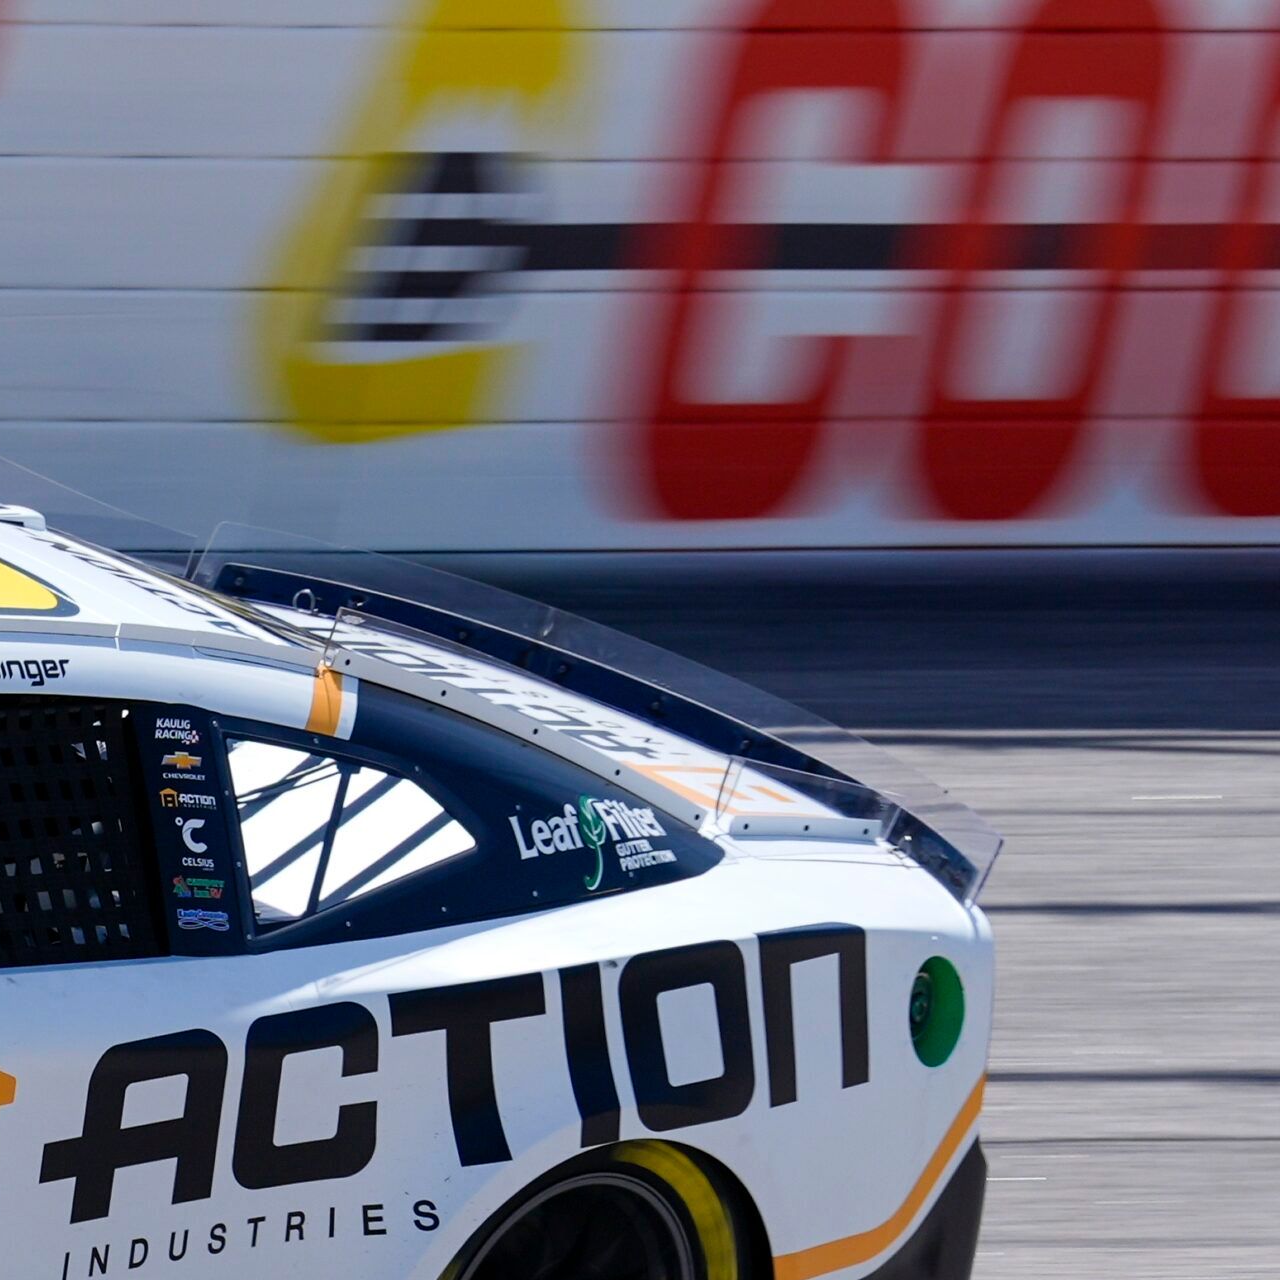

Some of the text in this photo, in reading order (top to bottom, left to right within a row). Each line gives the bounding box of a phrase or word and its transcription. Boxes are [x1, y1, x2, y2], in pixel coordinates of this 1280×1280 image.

[156, 718, 190, 729] KAULIG
[155, 729, 191, 740] RACING
[162, 772, 206, 781] CHEVROLET
[178, 793, 216, 806] ACTION
[182, 857, 214, 868] CELSIUS
[38, 924, 870, 1224] ACTION
